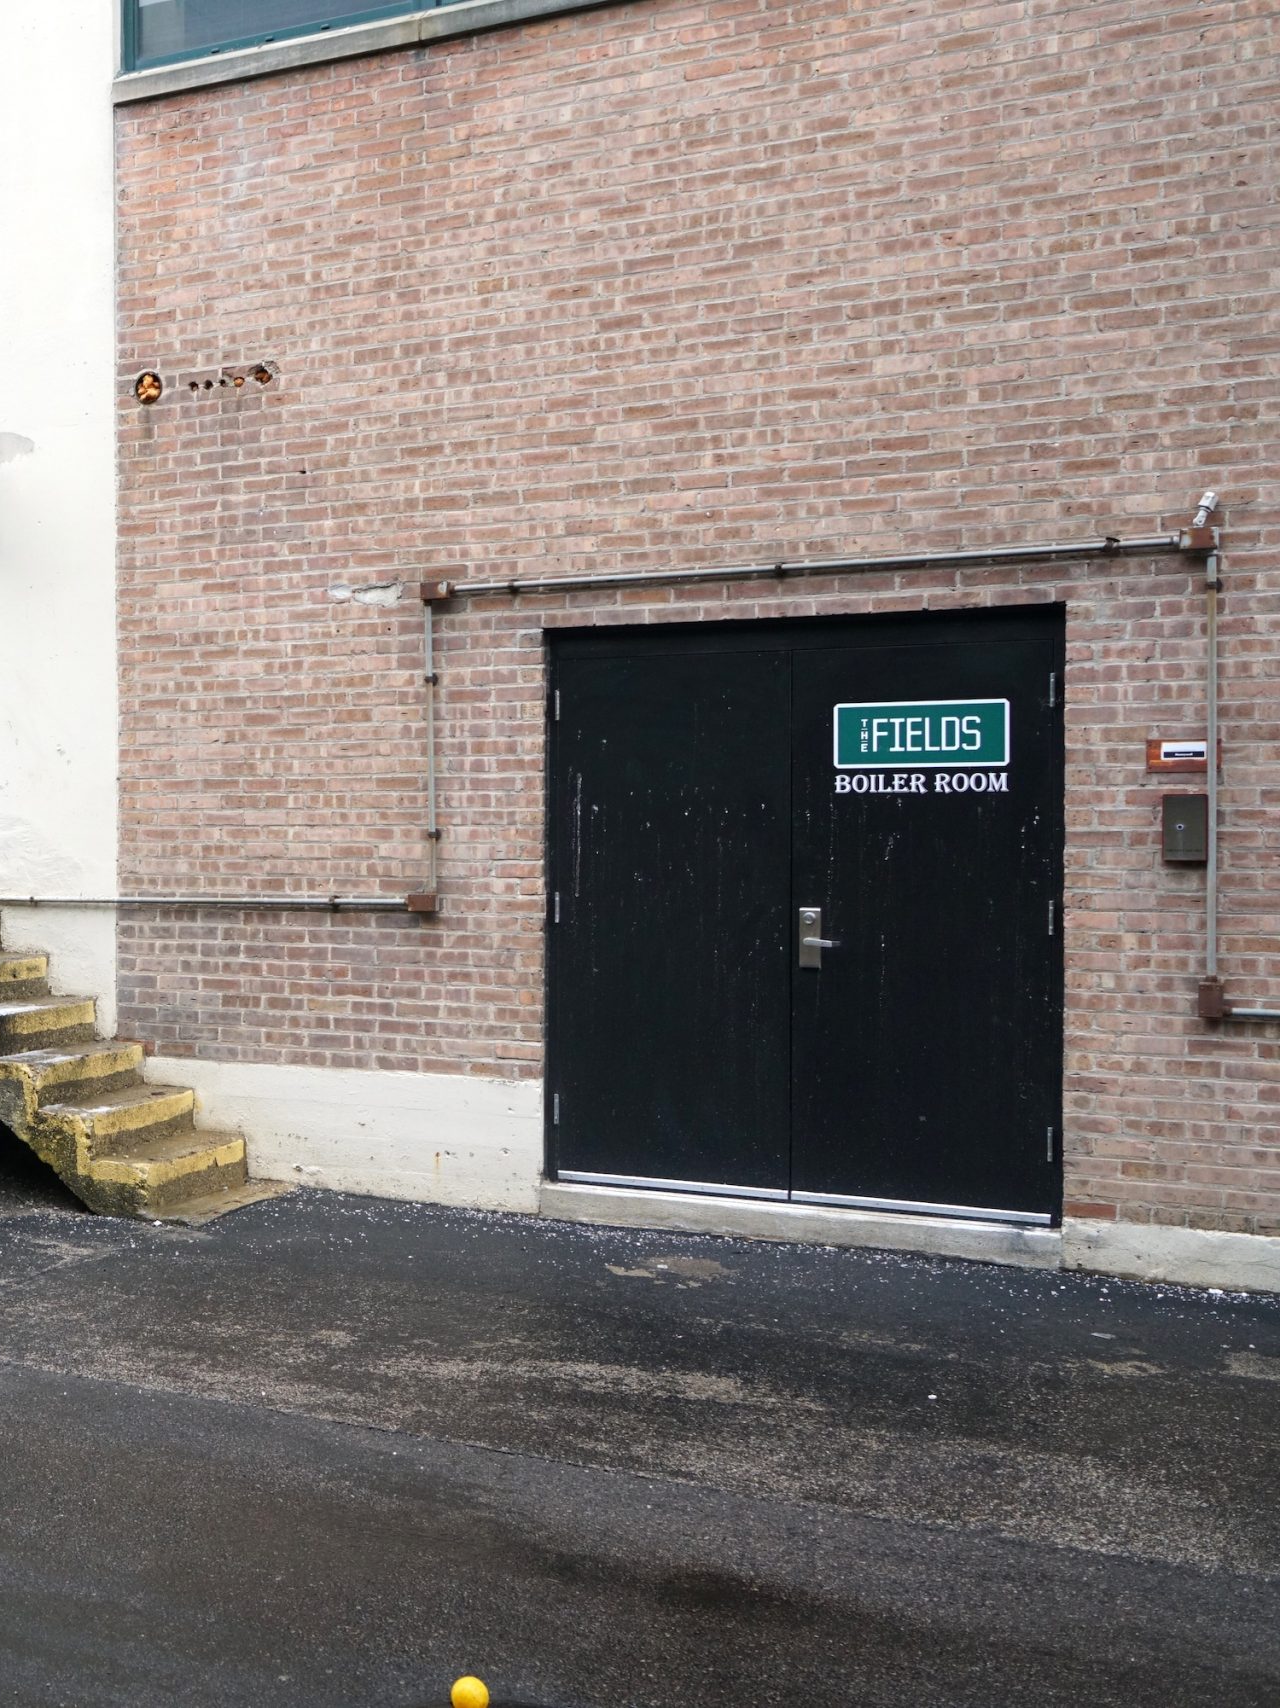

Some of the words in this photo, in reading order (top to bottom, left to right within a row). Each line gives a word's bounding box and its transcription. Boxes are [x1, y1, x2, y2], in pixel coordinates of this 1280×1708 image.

[861, 718, 869, 753] THE
[873, 716, 981, 752] FIELDS
[834, 773, 928, 795] BOILER
[934, 772, 1009, 794] ROOM
